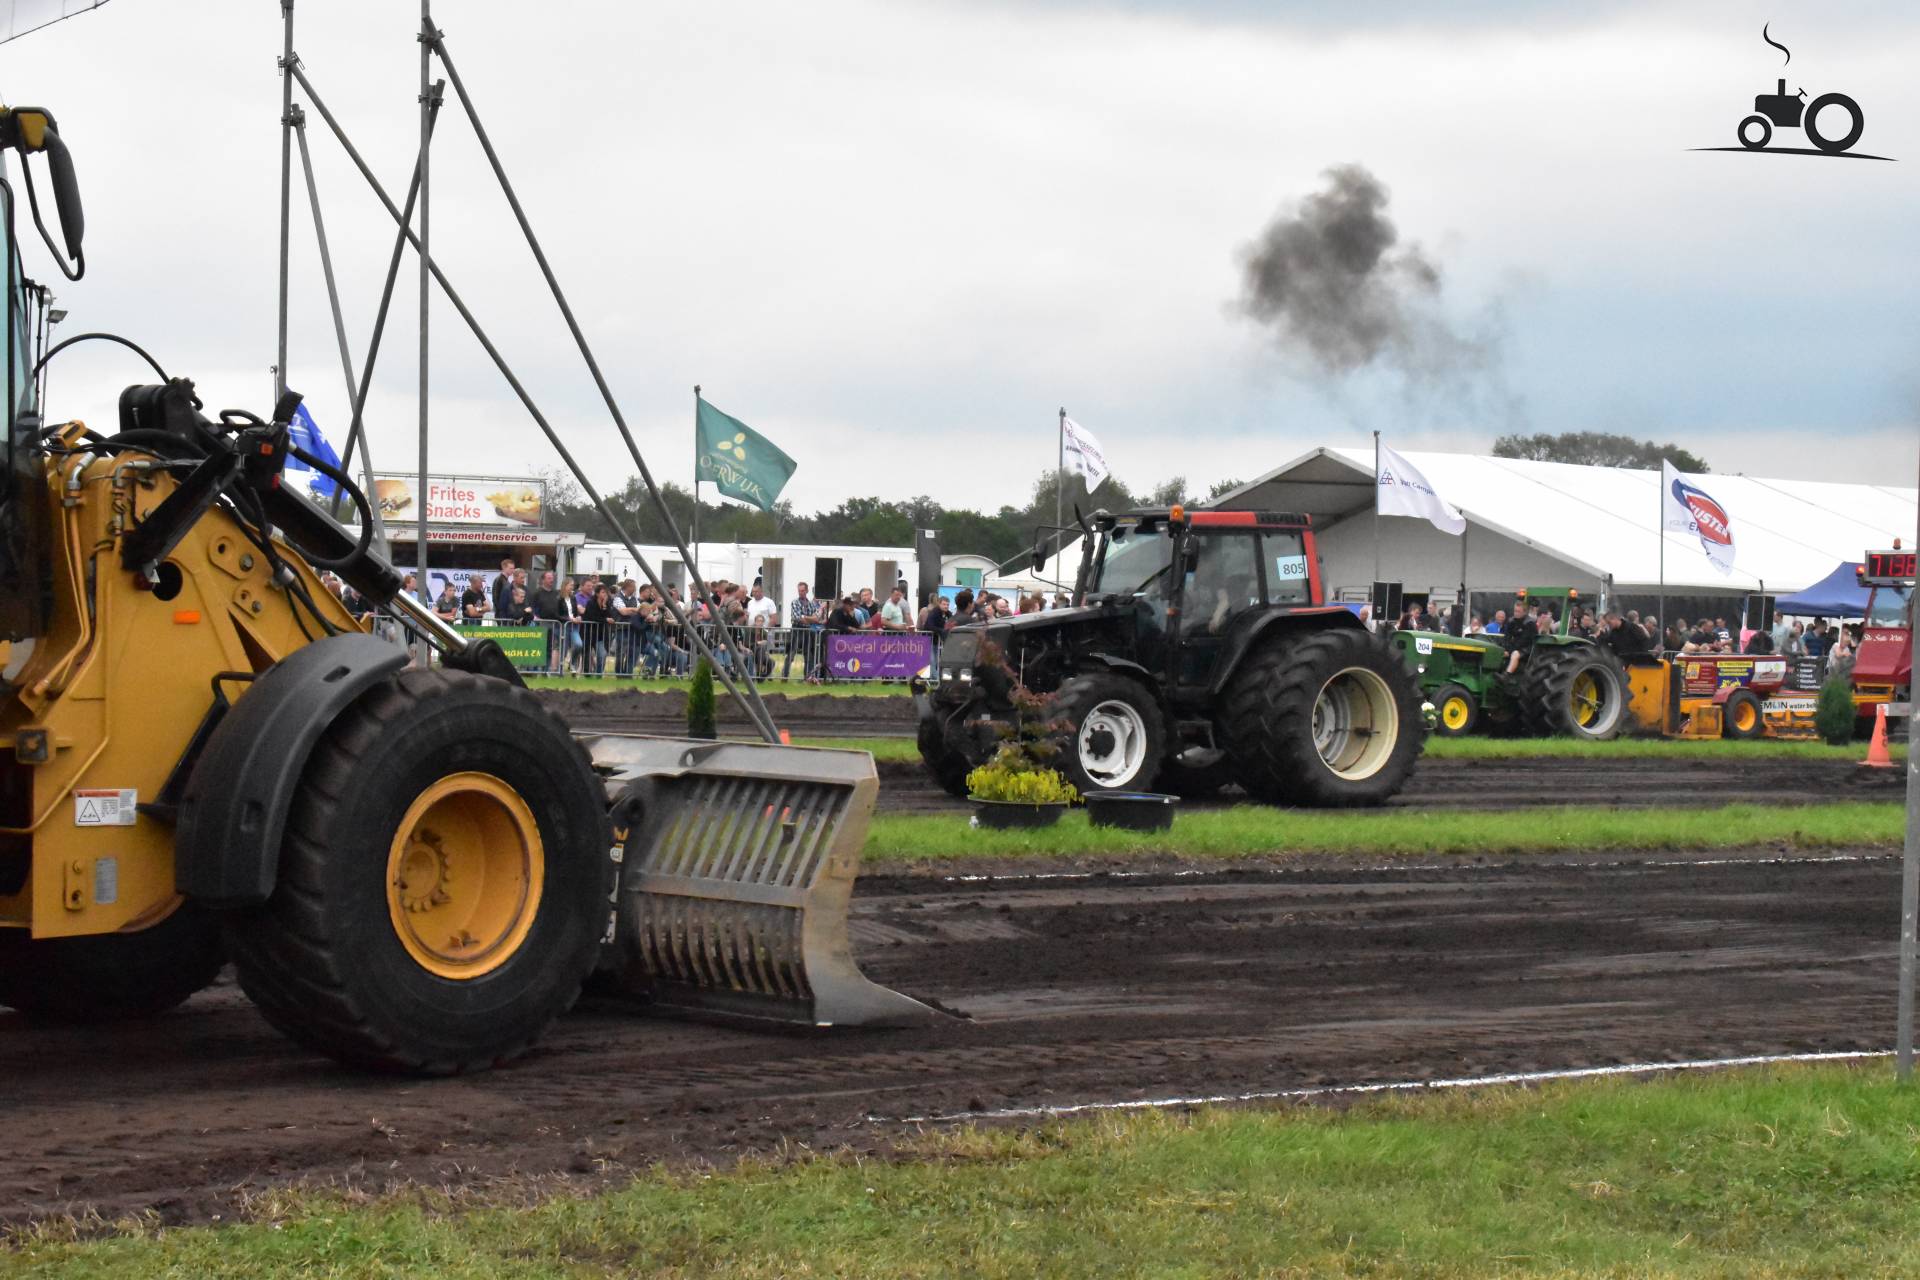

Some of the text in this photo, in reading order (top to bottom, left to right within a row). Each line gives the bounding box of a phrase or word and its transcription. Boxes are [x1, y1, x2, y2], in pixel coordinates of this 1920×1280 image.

[430, 486, 475, 501] Frites
[426, 503, 481, 518] Snacks
[426, 531, 538, 542] evenementenservice
[1283, 563, 1304, 575] 805
[453, 573, 487, 582] GARE
[835, 640, 924, 656] Overal dichtbij
